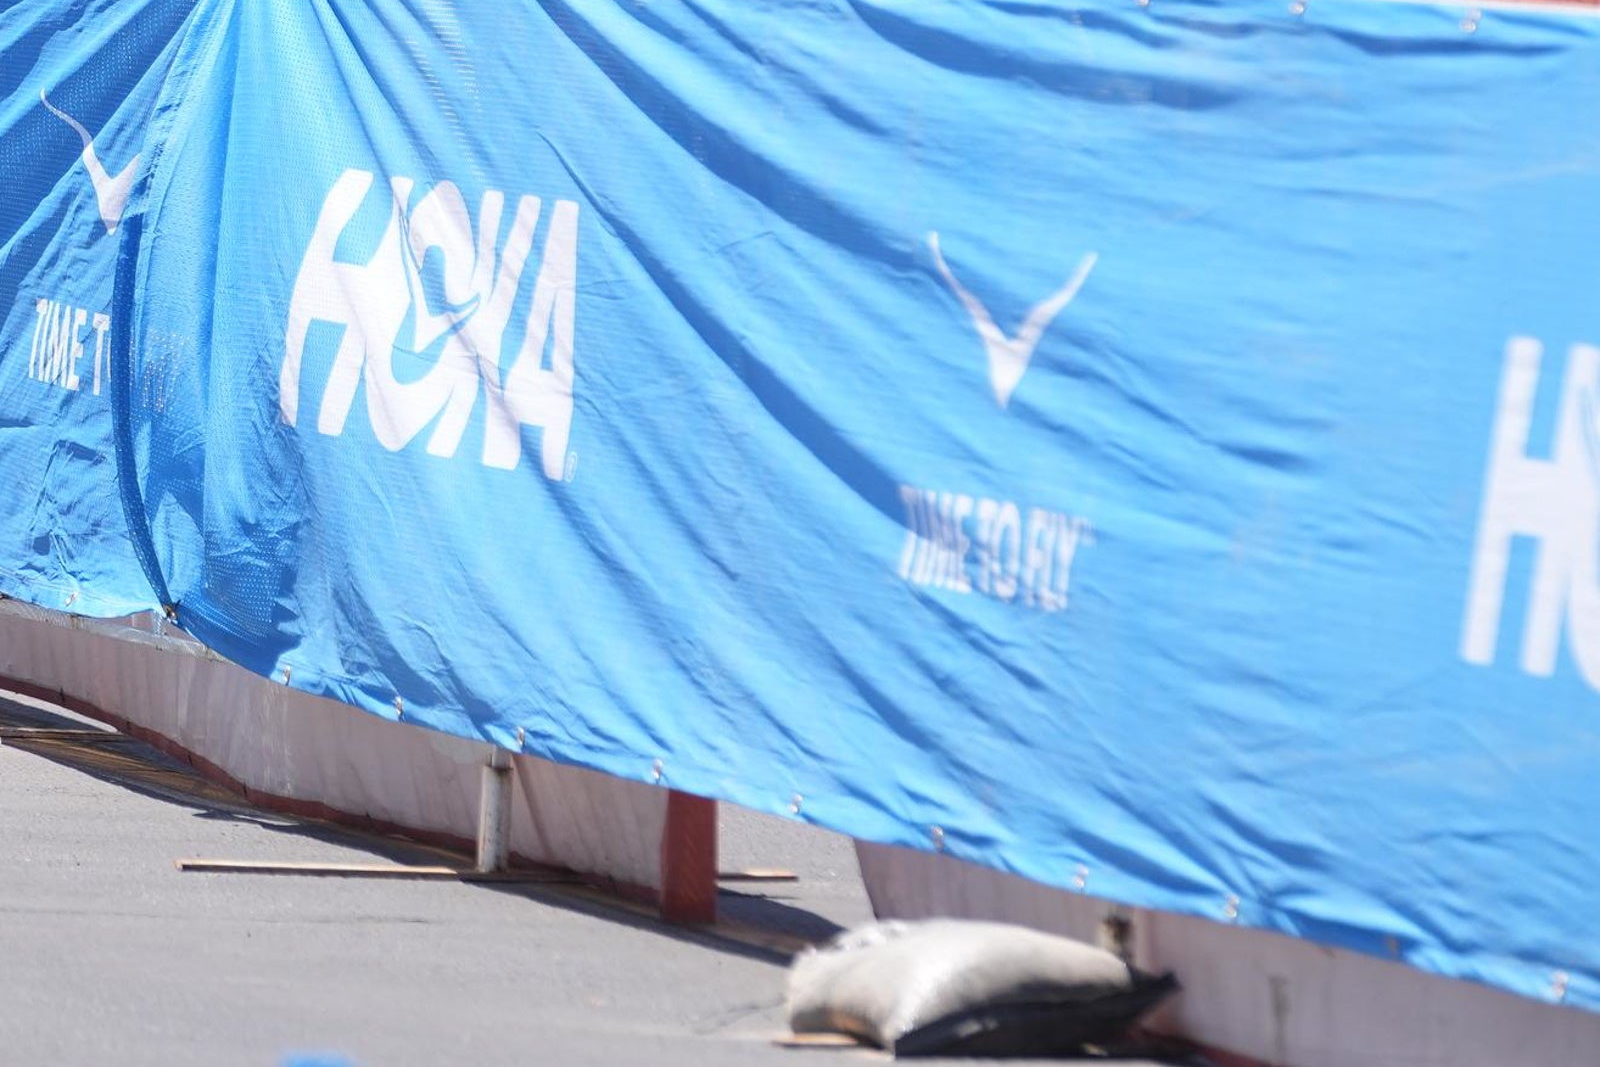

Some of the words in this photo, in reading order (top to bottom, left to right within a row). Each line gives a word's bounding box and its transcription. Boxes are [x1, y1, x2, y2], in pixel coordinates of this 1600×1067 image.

[29, 299, 87, 391] TIME
[92, 312, 113, 396] T
[280, 168, 580, 482] HOKA
